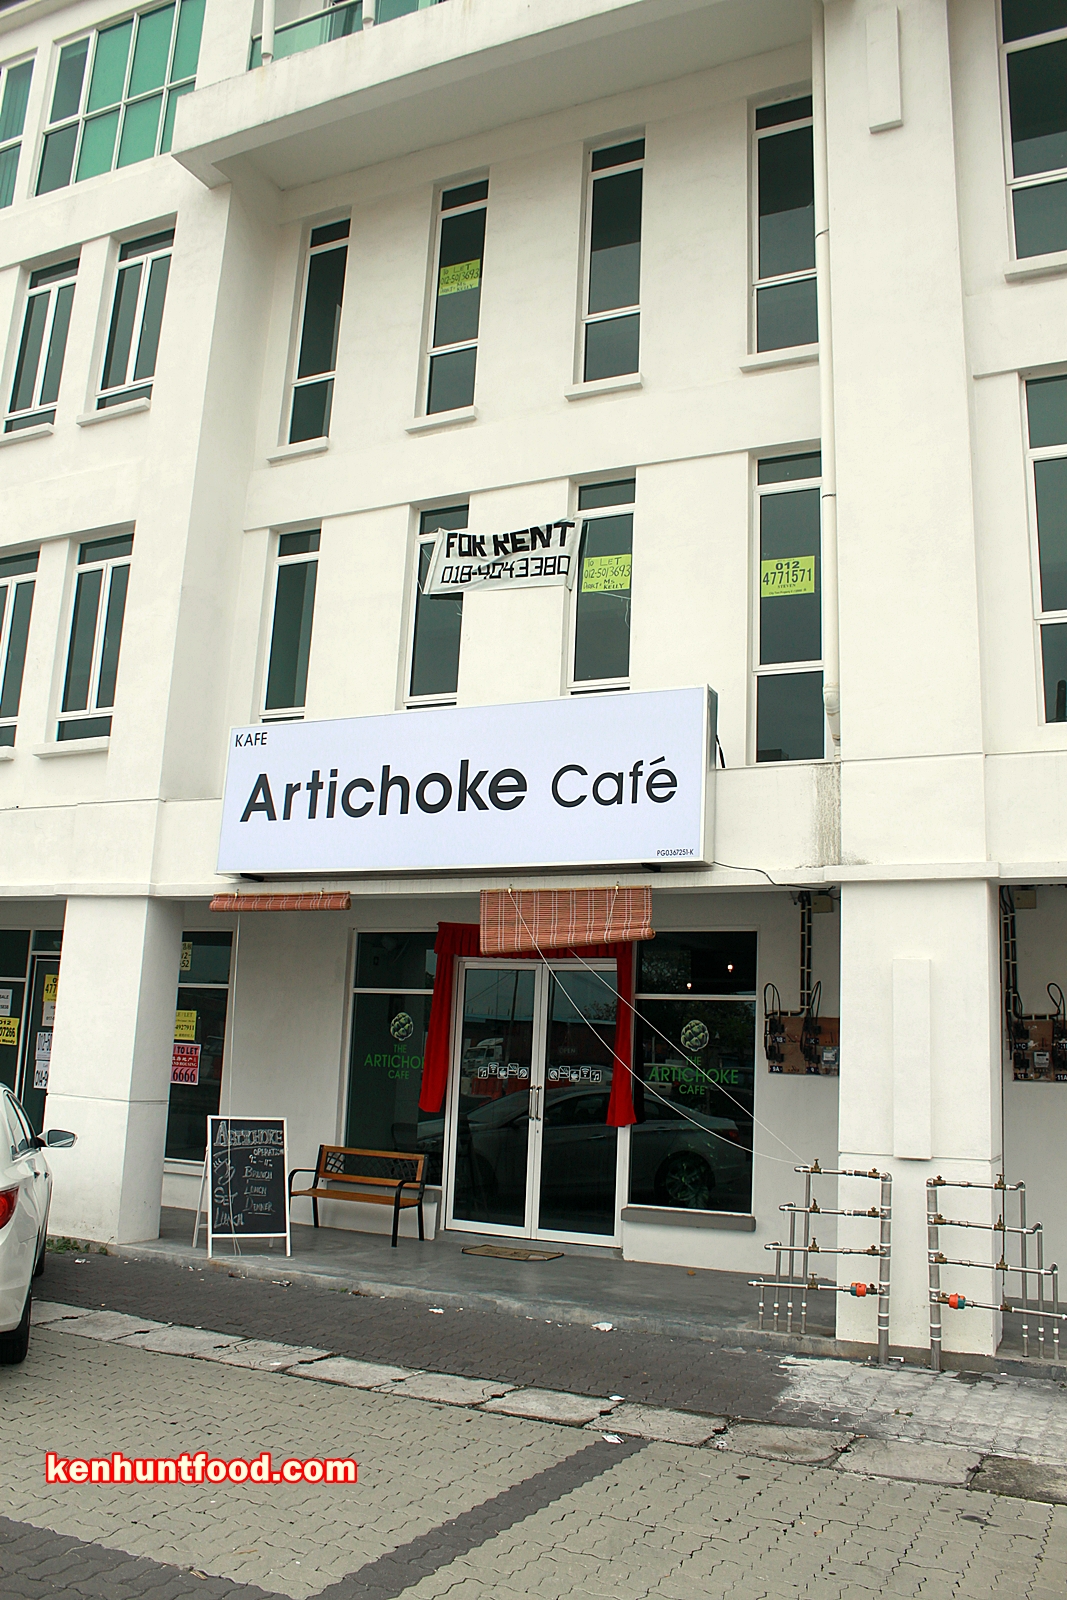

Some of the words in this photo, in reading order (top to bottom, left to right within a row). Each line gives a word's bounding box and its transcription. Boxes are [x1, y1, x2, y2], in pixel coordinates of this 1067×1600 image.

[600, 556, 622, 566] LET
[775, 561, 800, 571] 012
[440, 555, 571, 584] 018-4043380
[762, 568, 811, 586] 4771571
[235, 731, 268, 748] KAFE
[240, 759, 528, 823] Artichoke
[551, 755, 678, 808] Café
[177, 1046, 185, 1055] TO
[186, 1047, 198, 1055] LET
[394, 1044, 407, 1053] THE
[388, 1069, 409, 1079] CAFE
[648, 1067, 739, 1084] ARTICHOKE
[679, 1084, 705, 1095] CAFE
